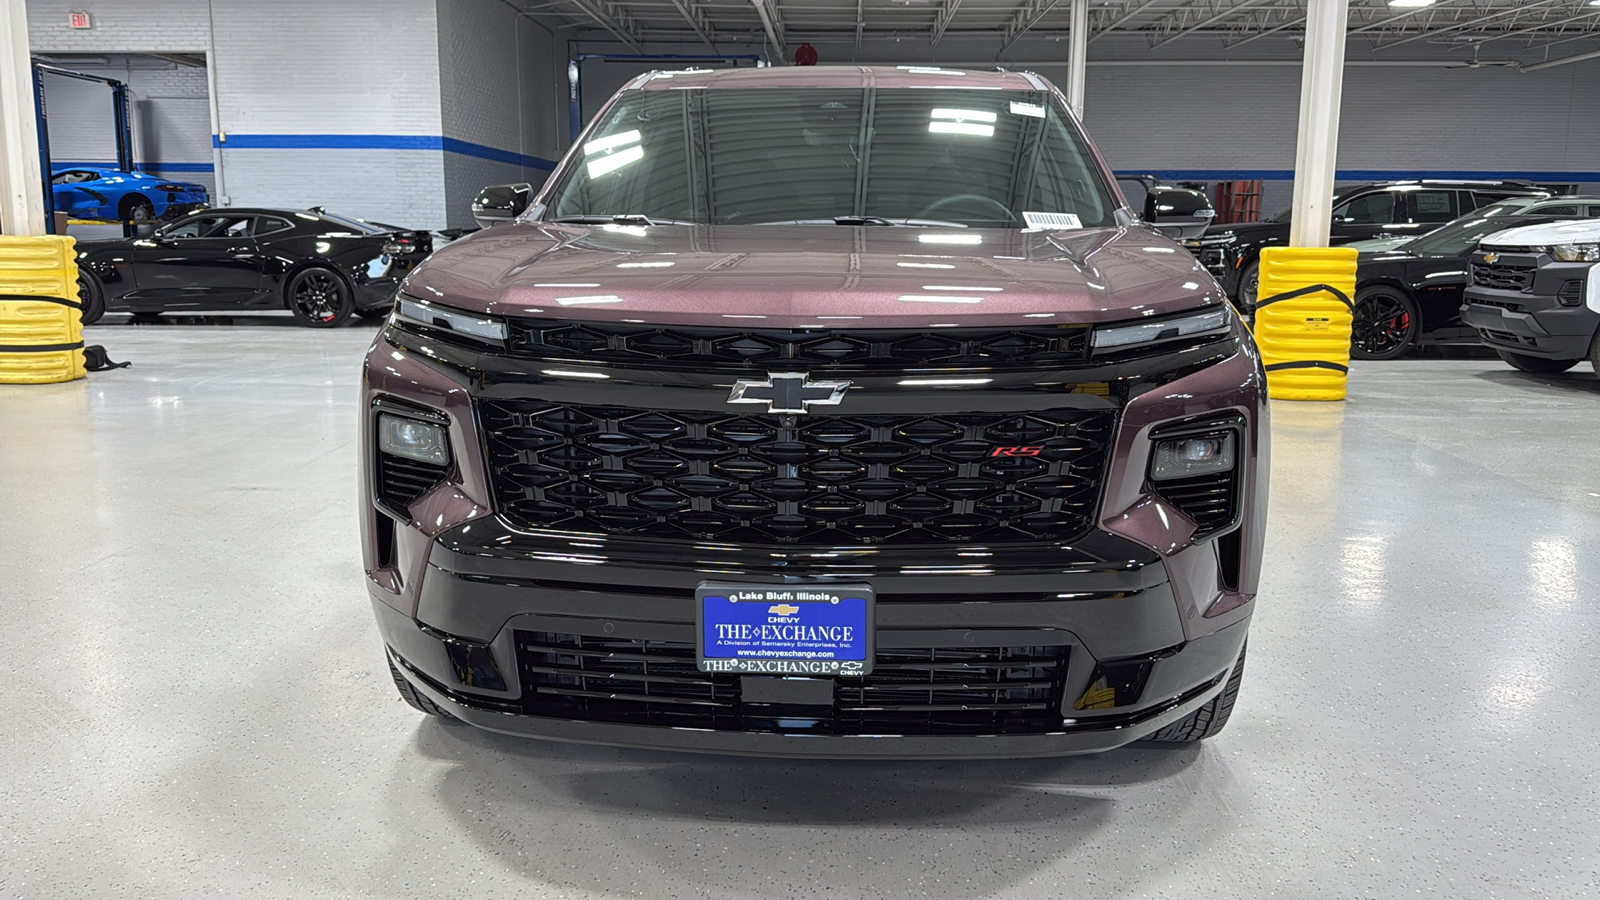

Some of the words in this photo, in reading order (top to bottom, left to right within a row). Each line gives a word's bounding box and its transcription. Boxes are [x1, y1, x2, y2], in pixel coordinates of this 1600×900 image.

[72, 14, 86, 26] EXIT
[990, 445, 1045, 457] RS
[739, 592, 763, 600] Lake
[766, 592, 794, 601] Bluff,
[797, 593, 830, 601] Illinois
[715, 624, 752, 639] THE
[761, 625, 853, 641] EXCHANGE
[737, 649, 834, 658] www.chevyexchange.com
[703, 660, 733, 671] THE
[748, 661, 832, 672] EXCHANGE
